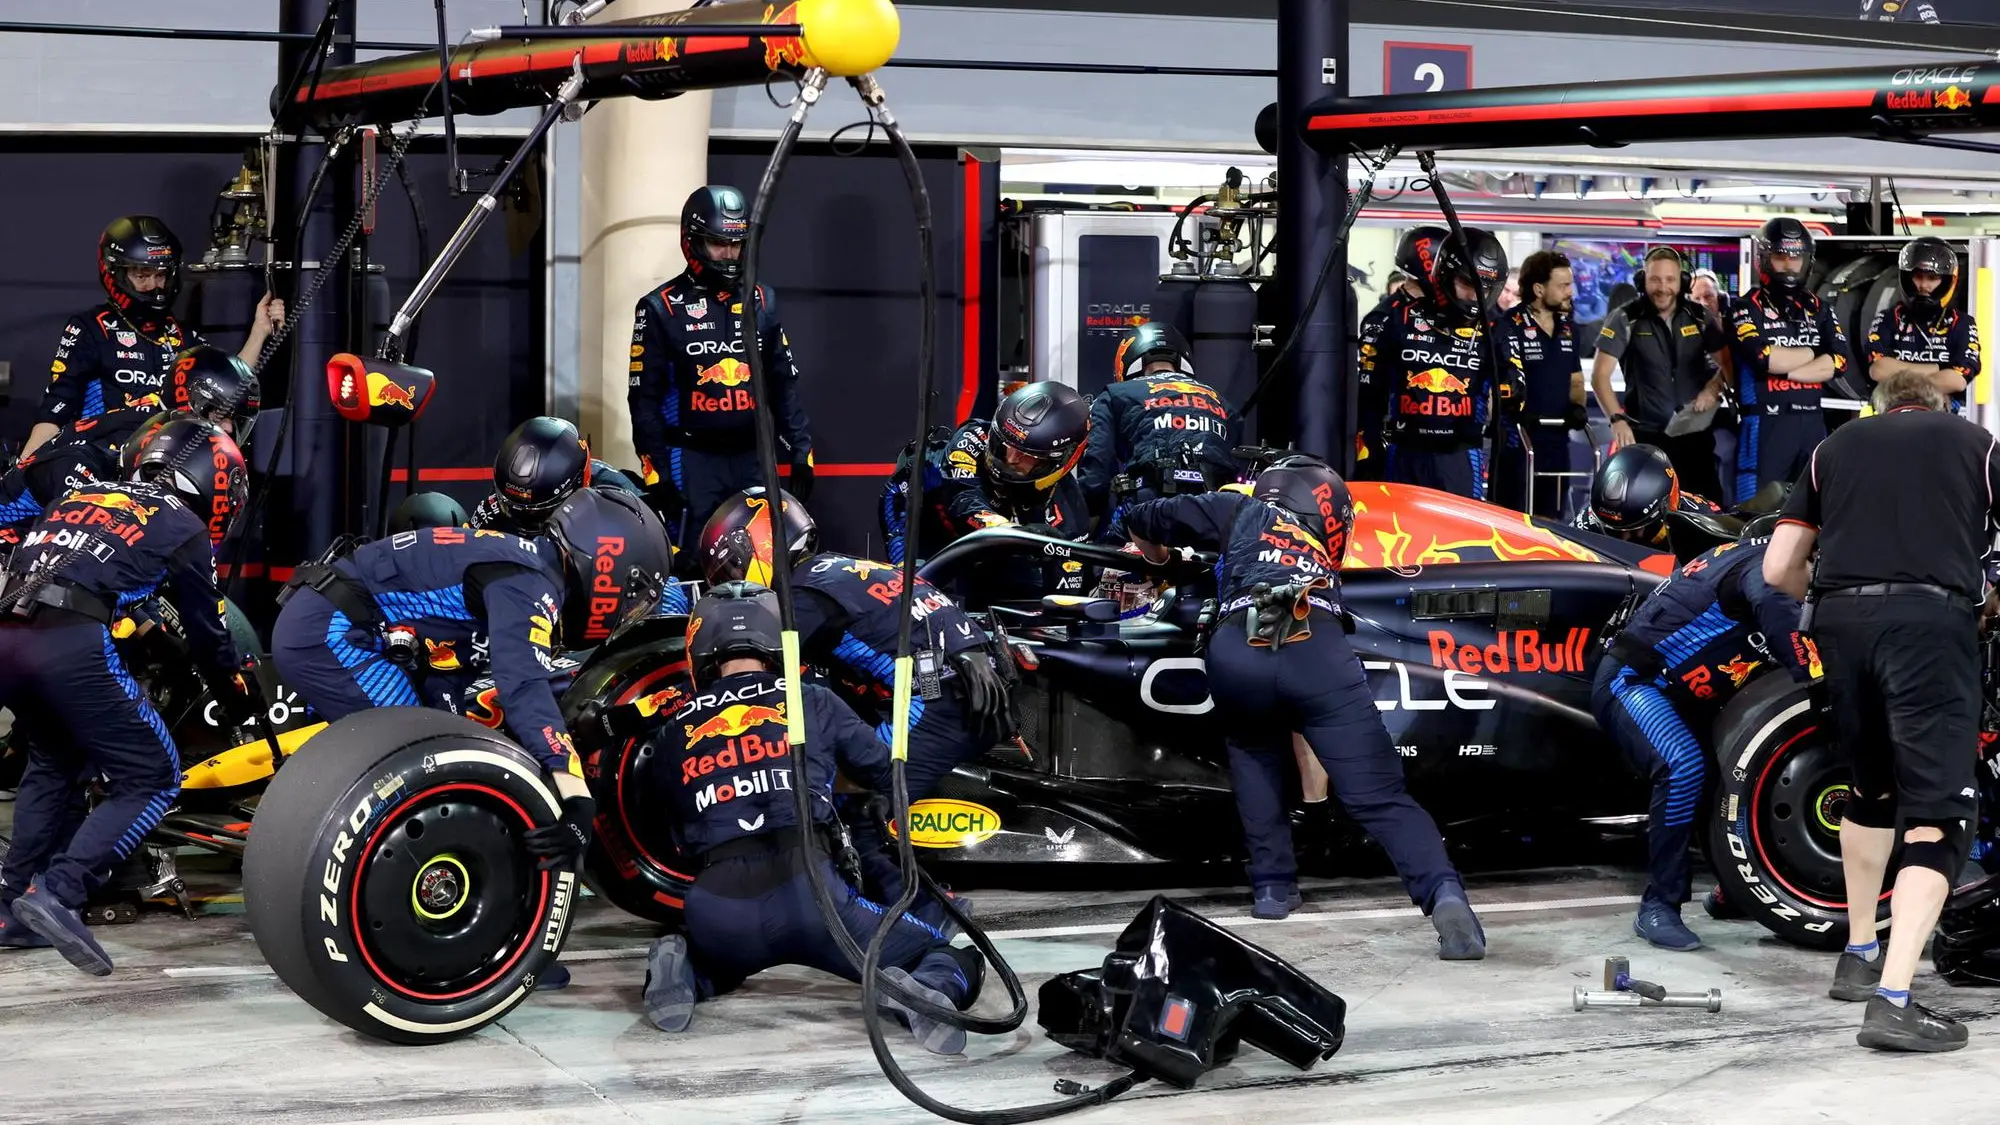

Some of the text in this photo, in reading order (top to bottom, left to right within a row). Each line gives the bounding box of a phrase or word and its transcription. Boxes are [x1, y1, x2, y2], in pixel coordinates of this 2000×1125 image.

[1414, 62, 1445, 92] 2
[1892, 66, 1980, 85] ORACLE
[1887, 90, 1932, 109] Red Bull
[1087, 315, 1121, 325] Red Bull
[1088, 304, 1150, 314] ORACLE
[686, 323, 707, 331] Mobil
[117, 351, 138, 359] Mobil
[1402, 349, 1481, 371] ORACLE
[176, 358, 195, 402] Red
[691, 389, 733, 412] Red
[1144, 394, 1189, 411] Red
[1401, 395, 1471, 416] Red Bull
[1154, 413, 1209, 431] Mobil
[966, 444, 980, 458] Sui
[951, 468, 975, 478] VISA
[1312, 482, 1343, 533] Red
[23, 529, 90, 551] Mobil
[1056, 546, 1071, 557] Sui
[584, 536, 625, 639] Red Bull
[866, 571, 905, 606] Re
[1427, 627, 1591, 674] Red Bull
[1681, 664, 1717, 700] Re
[676, 678, 787, 720] ORACLE
[542, 725, 555, 744] Red
[682, 739, 738, 785] Red
[695, 769, 769, 812] Mobil
[910, 813, 984, 833] RAUCH
[320, 796, 373, 963] P ZERO
[1726, 833, 1834, 933] P ZERO
